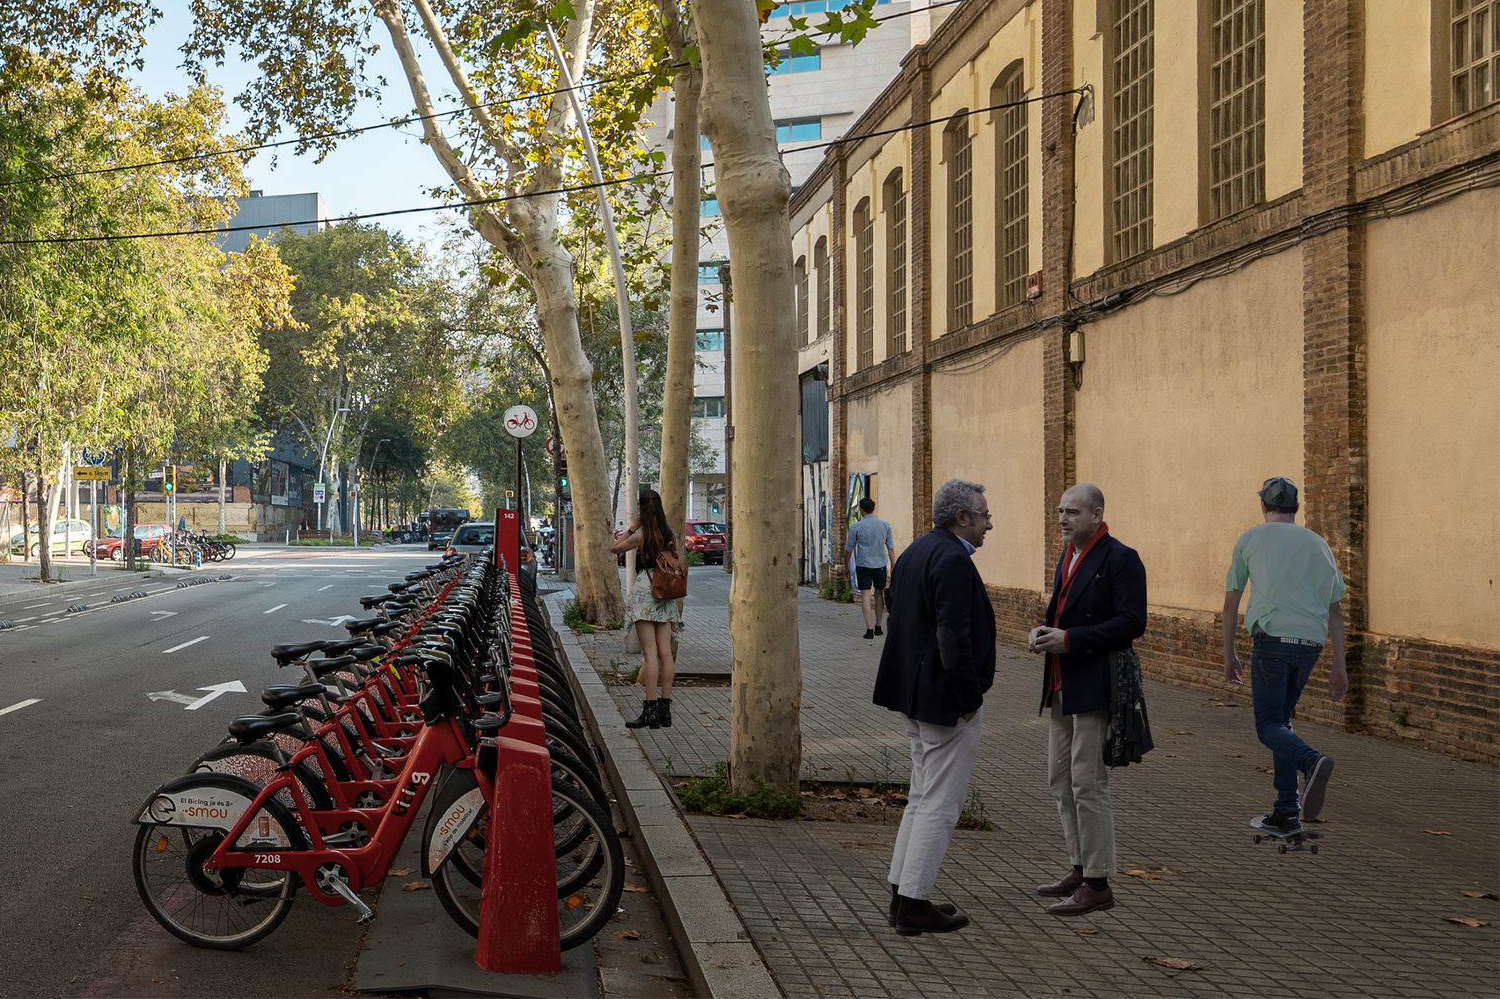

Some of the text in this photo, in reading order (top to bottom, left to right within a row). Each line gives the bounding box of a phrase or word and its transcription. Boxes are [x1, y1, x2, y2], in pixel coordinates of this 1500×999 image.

[391, 771, 430, 817] bicing
[188, 798, 209, 807] Bicing
[188, 806, 228, 819] smou
[440, 804, 466, 835] smou
[452, 827, 459, 835] de
[254, 854, 281, 864] 7208
